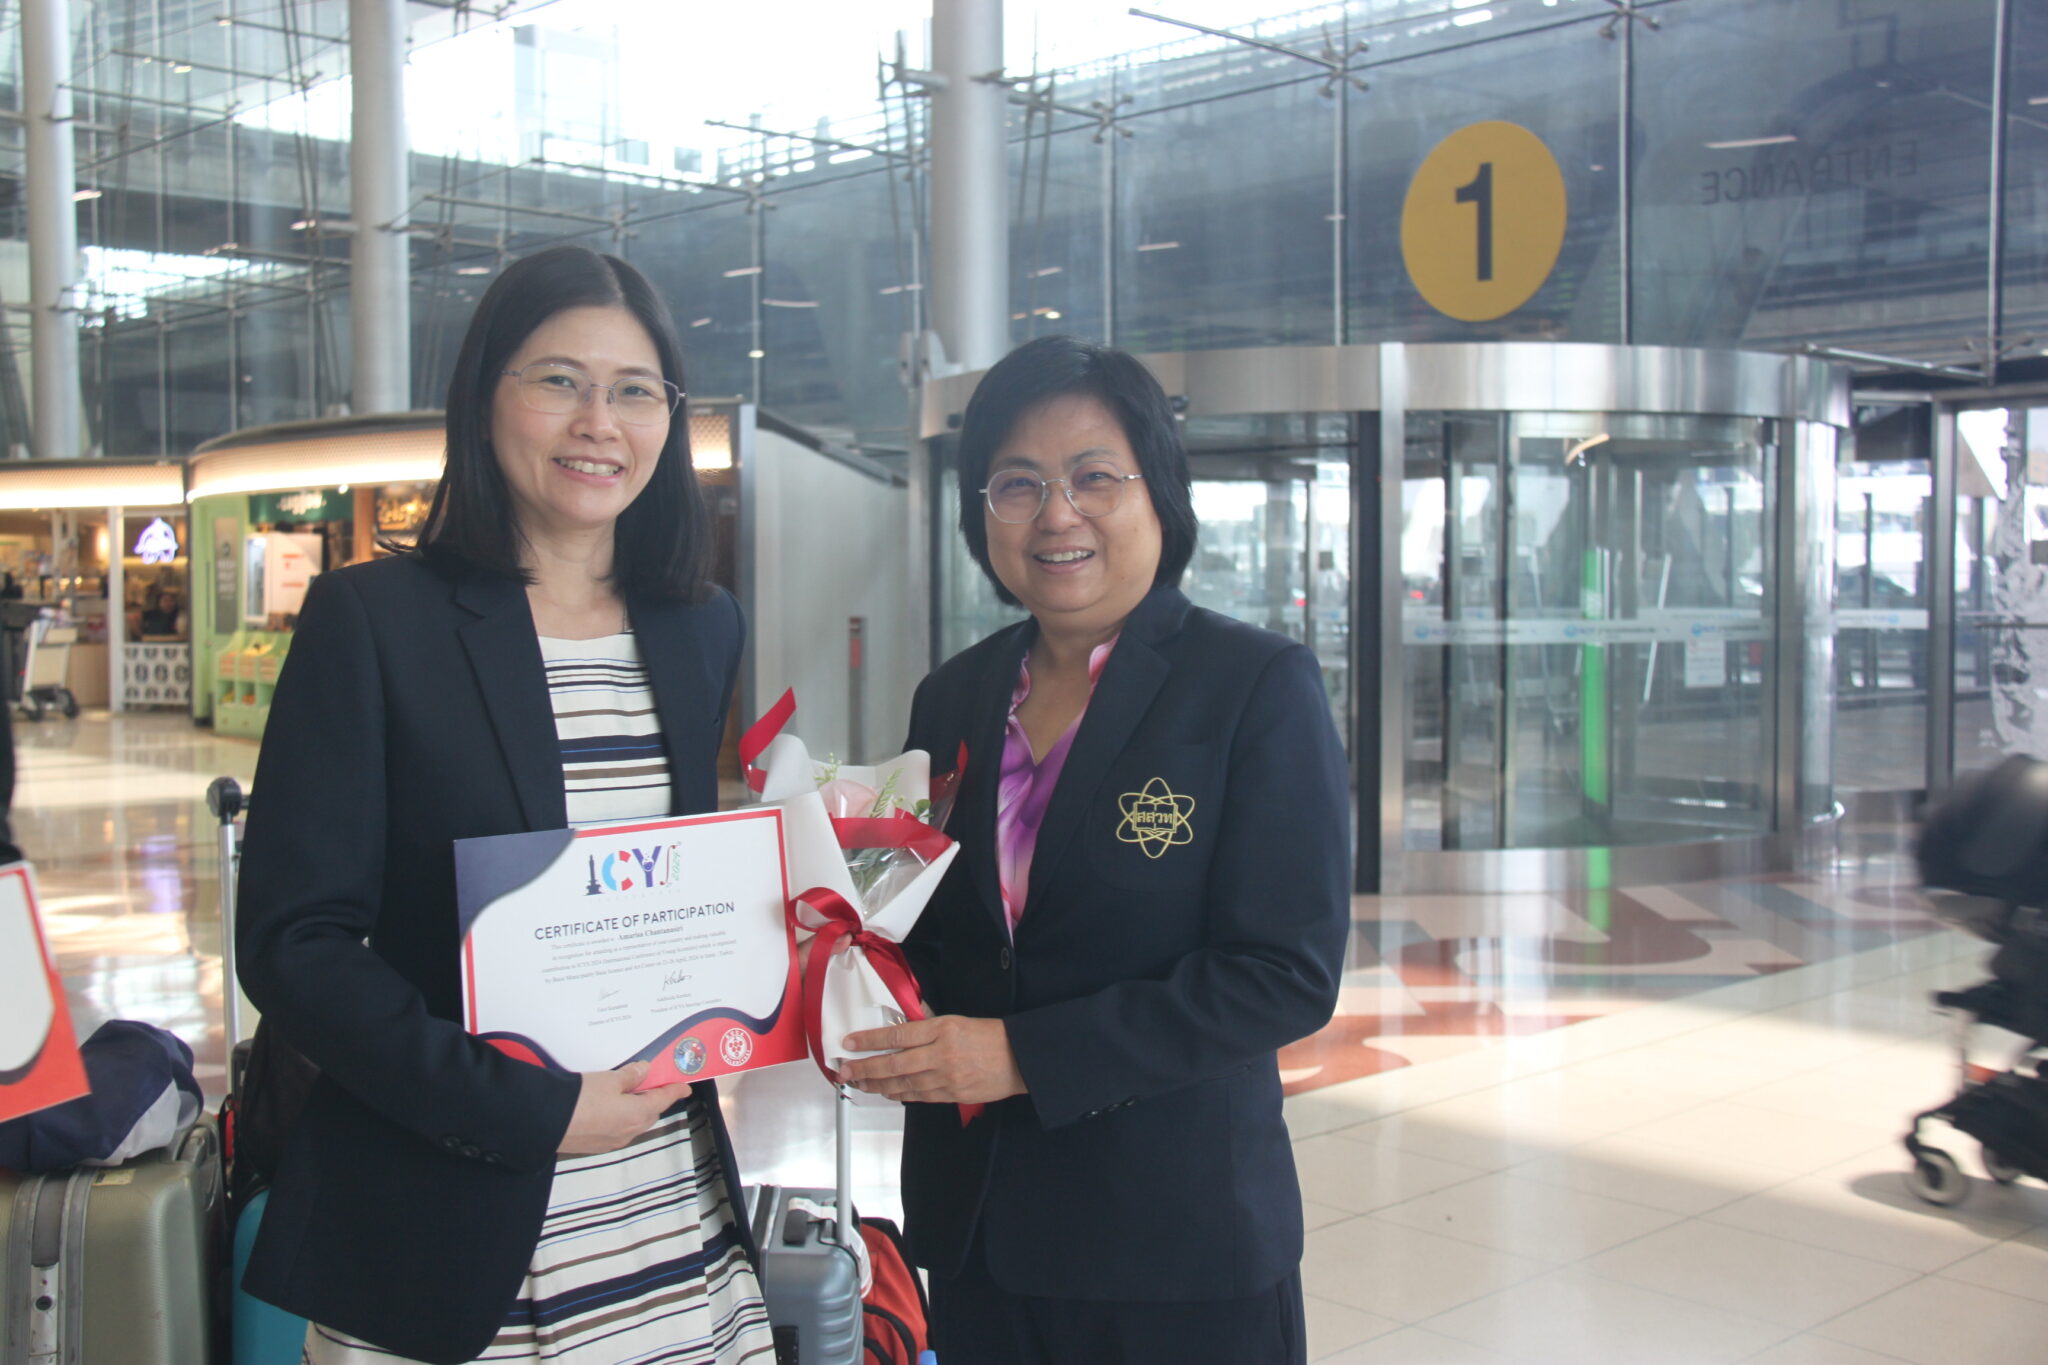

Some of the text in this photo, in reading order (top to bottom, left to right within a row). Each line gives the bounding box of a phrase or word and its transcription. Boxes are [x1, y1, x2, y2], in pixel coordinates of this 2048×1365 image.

[1455, 162, 1493, 281] 1
[534, 901, 735, 940] CERTIFICATE OF PARTICIPATION
